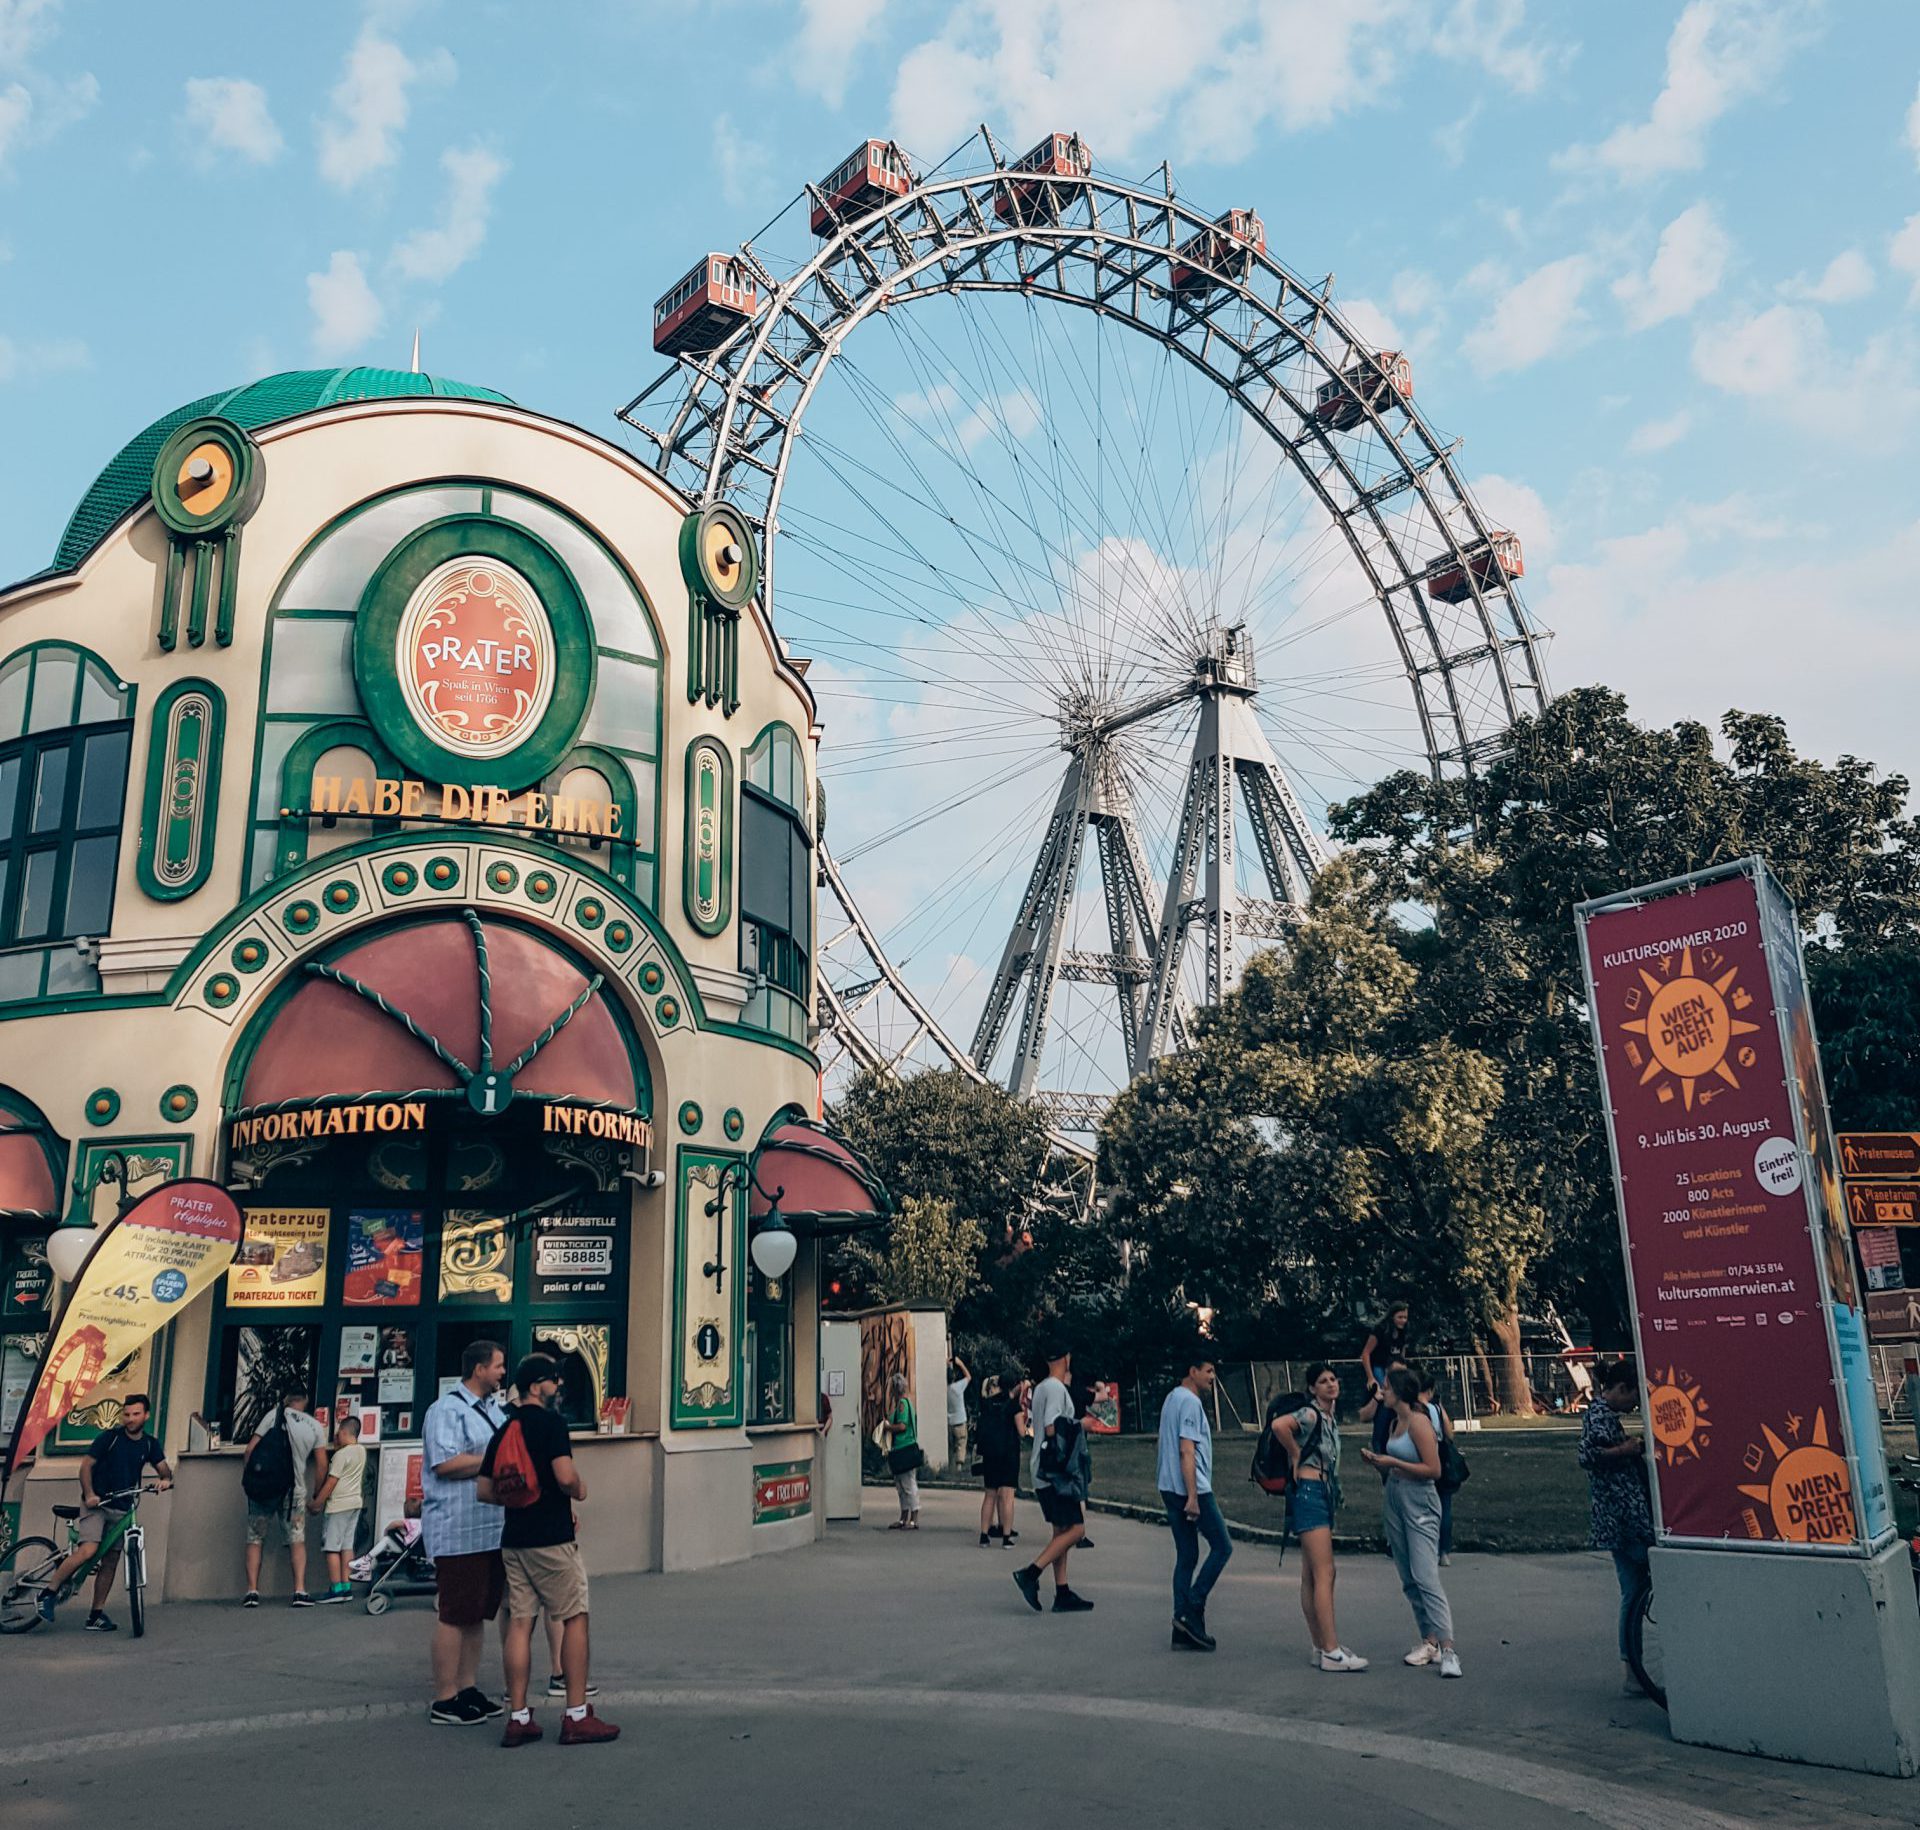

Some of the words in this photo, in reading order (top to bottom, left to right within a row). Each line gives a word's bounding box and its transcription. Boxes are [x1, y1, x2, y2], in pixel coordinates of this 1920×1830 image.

[421, 636, 533, 675] PRATER
[471, 681, 481, 691] in
[484, 682, 510, 695] Wien
[455, 693, 472, 702] seit
[475, 694, 498, 704] 1766
[311, 777, 424, 816] HABE
[440, 784, 510, 824] DIE
[525, 792, 623, 839] EHRE
[1603, 929, 1713, 968] KULTURSOMMER
[1714, 921, 1748, 941] 2020
[1661, 994, 1705, 1027] WIEN
[1661, 1008, 1714, 1046] DREHT
[1677, 1031, 1714, 1058] AUF!
[232, 1103, 426, 1148] INFORMATION
[1638, 1134, 1650, 1149] 9.
[1653, 1130, 1675, 1147] Juli
[1677, 1128, 1696, 1143] bis
[1698, 1125, 1720, 1140] 30.
[1722, 1118, 1771, 1138] August
[1676, 1173, 1690, 1185] 25
[1691, 1168, 1742, 1184] Locations
[1770, 1167, 1794, 1185] frei!
[1688, 1190, 1709, 1202] 800
[1711, 1188, 1734, 1200] Acts
[1865, 1188, 1917, 1201] Planetarium
[170, 1196, 213, 1212] PRATER
[174, 1209, 227, 1228] Highlights
[1663, 1210, 1690, 1223] 2000
[1682, 1225, 1703, 1239] und
[1705, 1222, 1750, 1237] Künstler
[545, 1241, 606, 1249] WIEN-TICKET.AT
[171, 1248, 205, 1260] PRATER
[563, 1251, 605, 1263] 58885
[1728, 1264, 1753, 1278] 01/34
[1755, 1263, 1767, 1274] 35
[1767, 1262, 1784, 1274] 814
[233, 1291, 285, 1300] PRATERZUG
[288, 1291, 317, 1300] TICKET
[543, 1281, 569, 1294] point
[572, 1281, 582, 1291] of
[585, 1281, 606, 1291] sale
[1658, 1279, 1796, 1301] kultursommerwien.at
[1655, 1398, 1682, 1413] WIEN
[1655, 1408, 1687, 1425] DREHT
[1664, 1420, 1686, 1434] AUF!
[1786, 1471, 1842, 1503] WIEN
[1786, 1493, 1853, 1526] DREHT
[1806, 1514, 1852, 1542] AUF!
